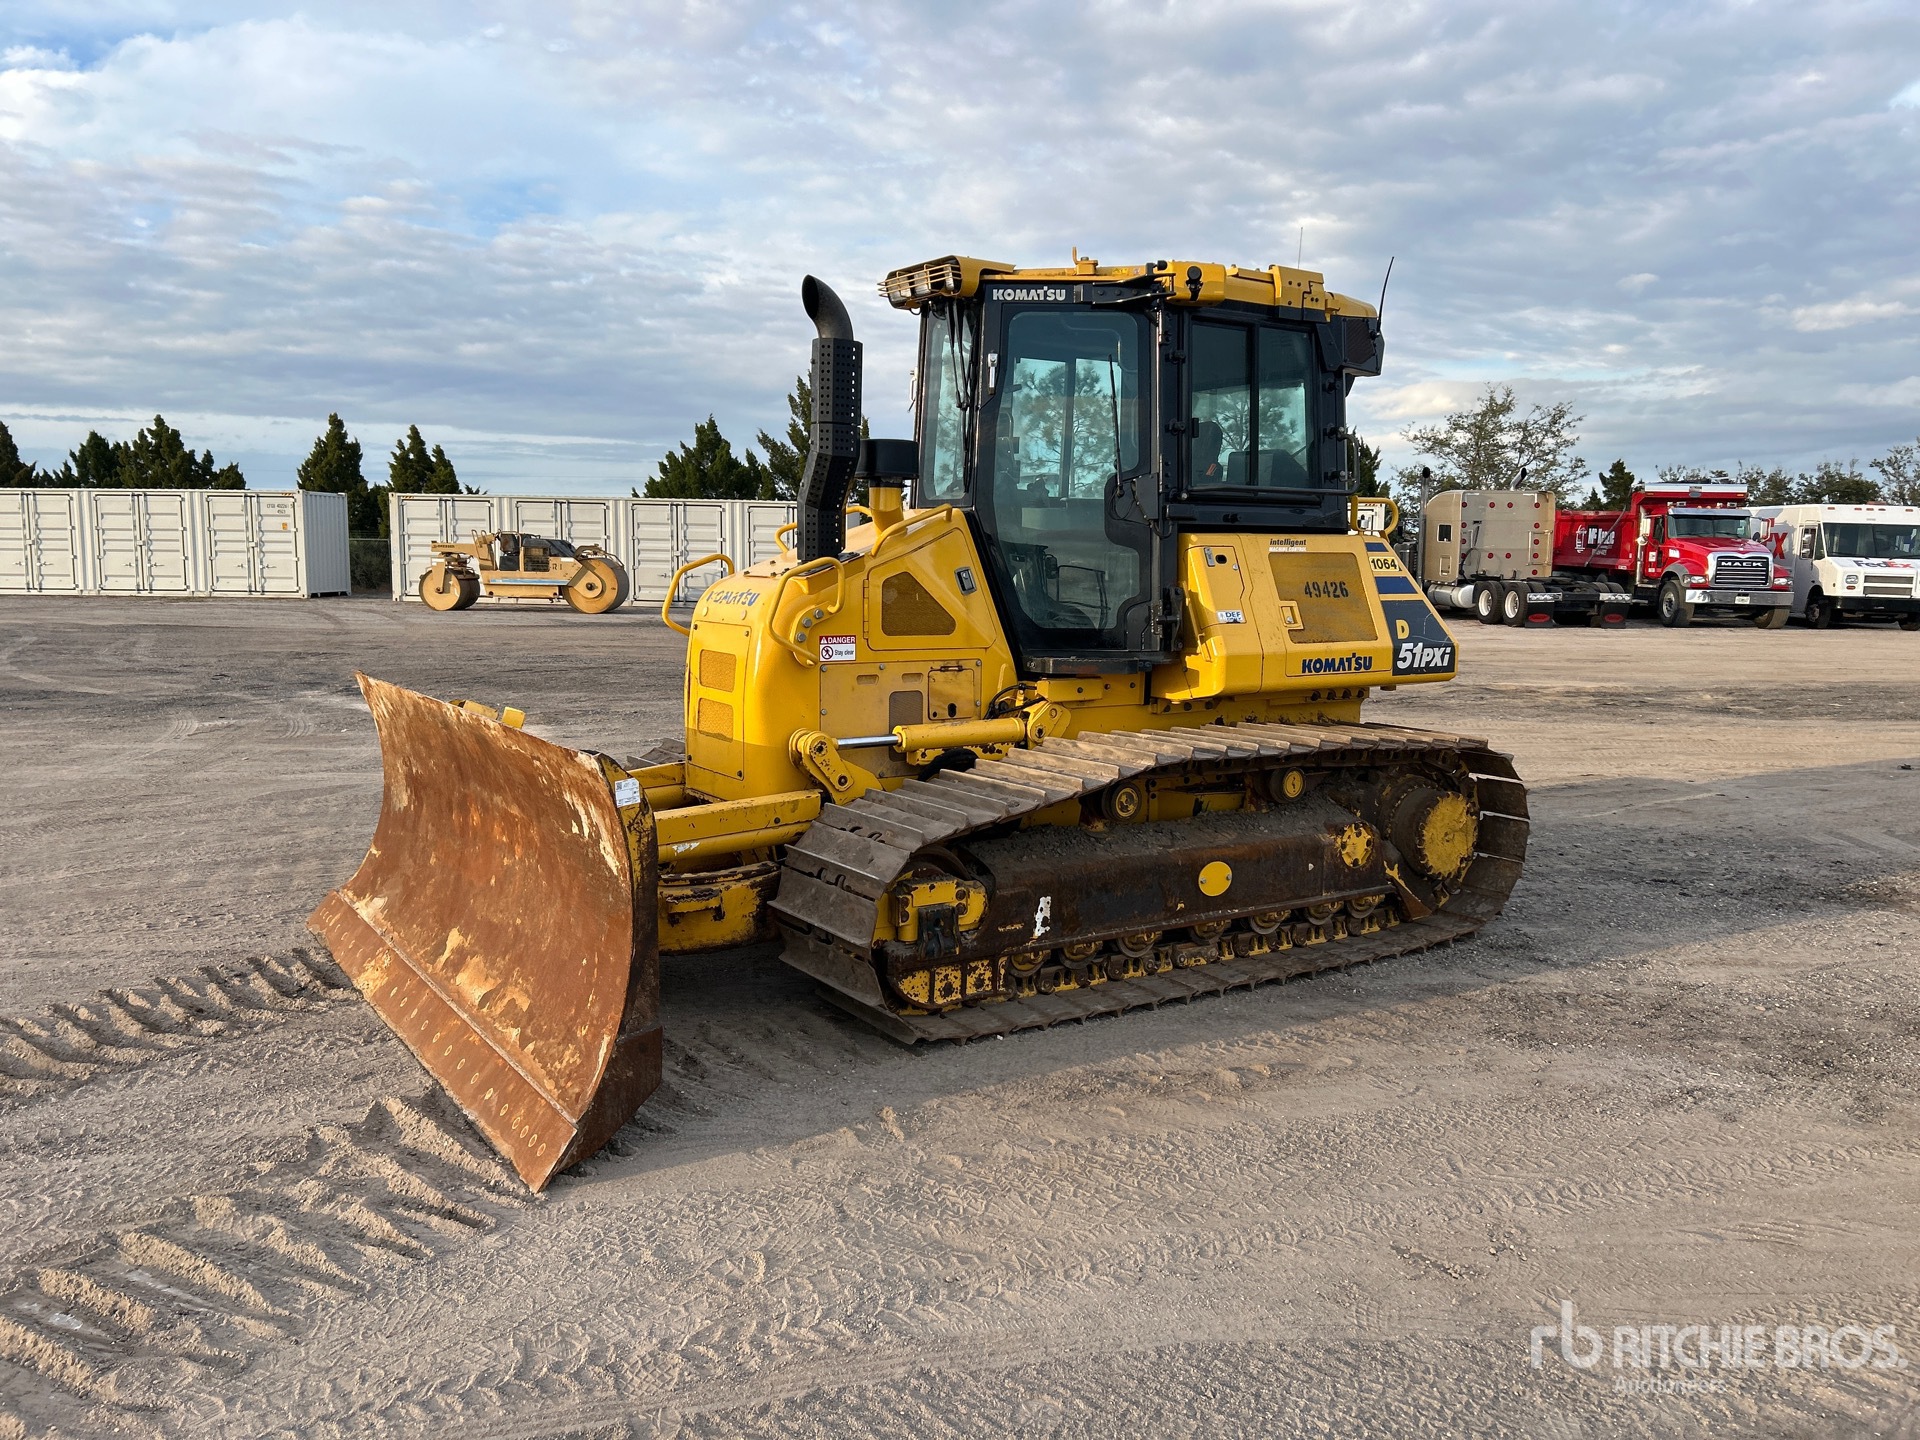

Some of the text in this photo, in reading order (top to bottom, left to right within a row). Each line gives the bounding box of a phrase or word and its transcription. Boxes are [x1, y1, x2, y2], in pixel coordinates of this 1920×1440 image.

[993, 286, 1066, 301] KOMATSU
[1269, 538, 1307, 547] intelligent
[1371, 559, 1397, 570] 1064
[1853, 560, 1914, 569] FedEx
[1304, 581, 1349, 598] 49426
[1396, 620, 1410, 639] D
[828, 636, 856, 644] DANGER
[1302, 652, 1373, 674] KOMATSU
[1396, 642, 1452, 669] 51PXi
